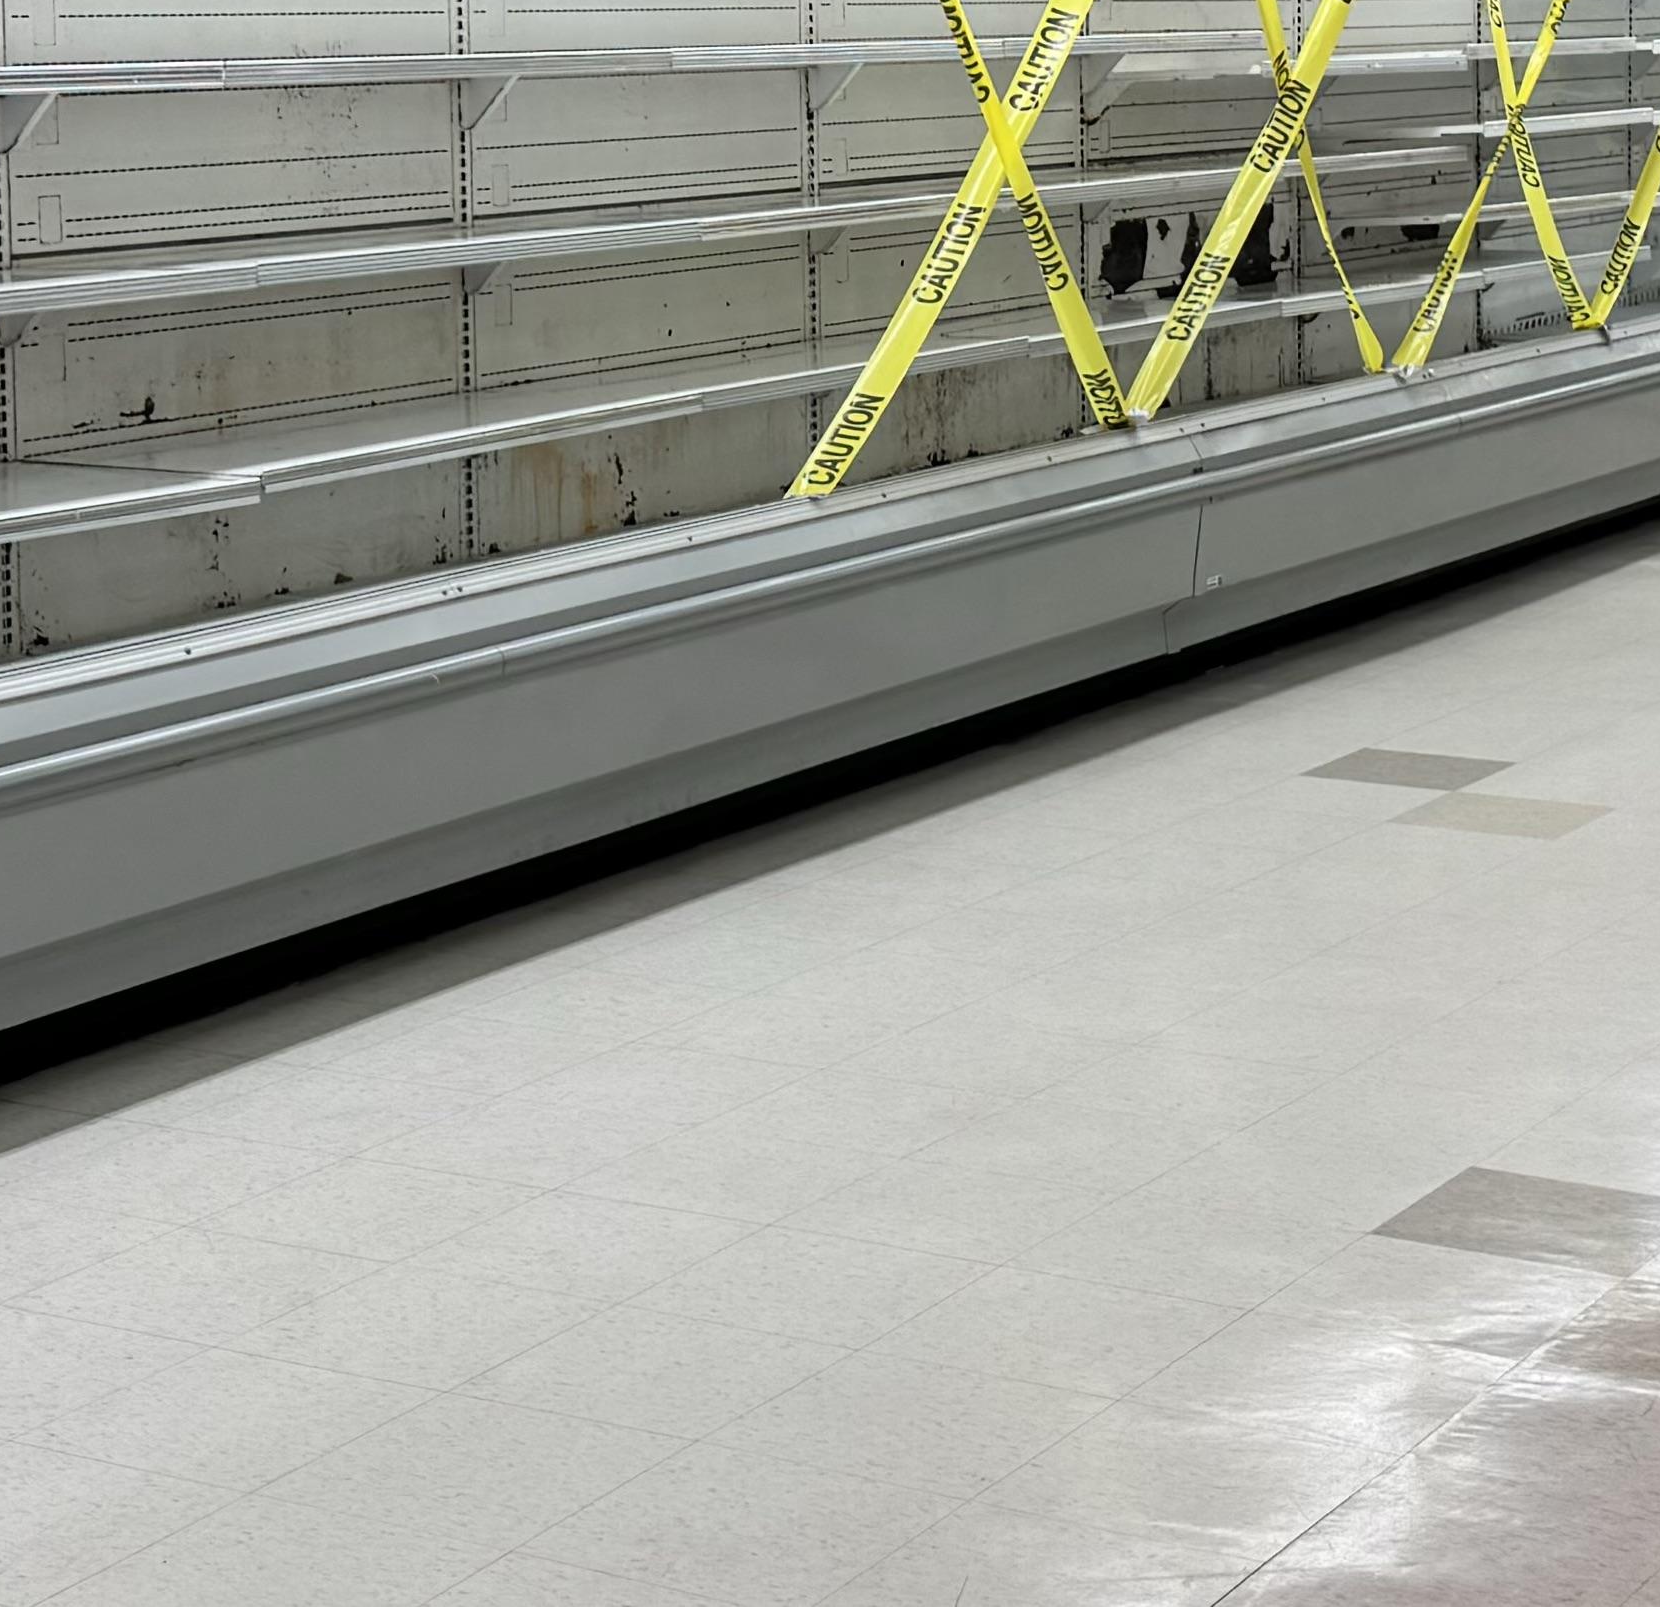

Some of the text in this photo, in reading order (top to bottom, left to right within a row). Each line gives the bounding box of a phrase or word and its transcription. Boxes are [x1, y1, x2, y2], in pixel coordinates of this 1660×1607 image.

[1009, 8, 1080, 112] CAUTION
[1250, 78, 1312, 174] CAUTION
[912, 202, 987, 305] CAUTION
[1166, 253, 1231, 342] CAUTION
[1600, 216, 1641, 296] CAUTION
[806, 393, 886, 486] CAUTION
